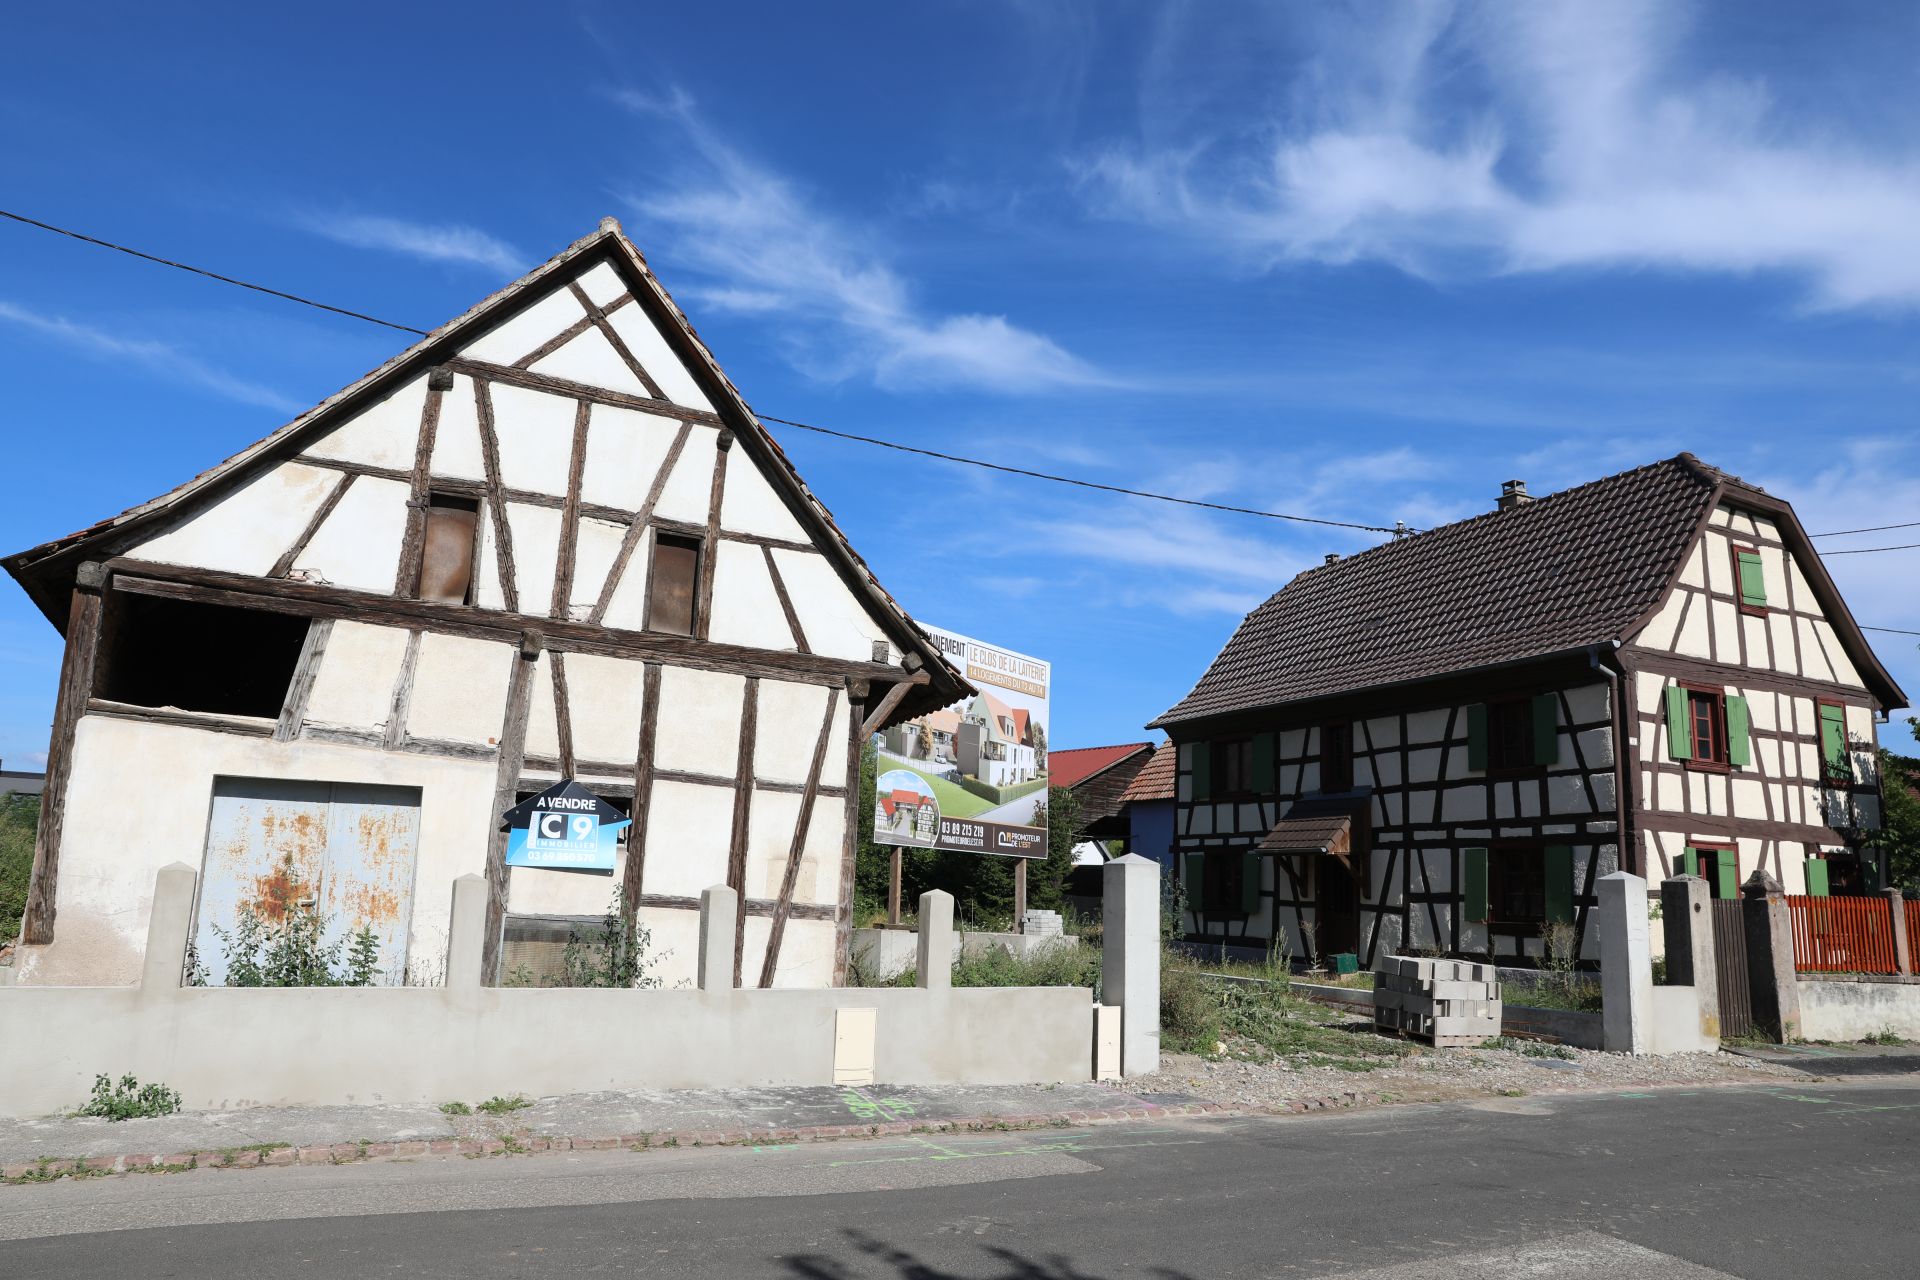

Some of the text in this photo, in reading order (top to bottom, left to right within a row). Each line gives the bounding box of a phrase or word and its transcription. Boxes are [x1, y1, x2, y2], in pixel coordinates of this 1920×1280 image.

[969, 646, 1045, 682] LE CLOS DE LA LAITERIE
[970, 666, 977, 677] 14
[977, 668, 1012, 687] LOGEMENTS
[1012, 678, 1021, 688] DU
[1028, 683, 1036, 693] AU
[537, 797, 597, 811] A VENDRE
[941, 821, 984, 838] 03 89 215 219
[1011, 832, 1041, 843] PROMOTEUR
[536, 840, 595, 849] IMMOBILIER
[1011, 840, 1031, 849] DE L'EST
[527, 850, 541, 861] 03
